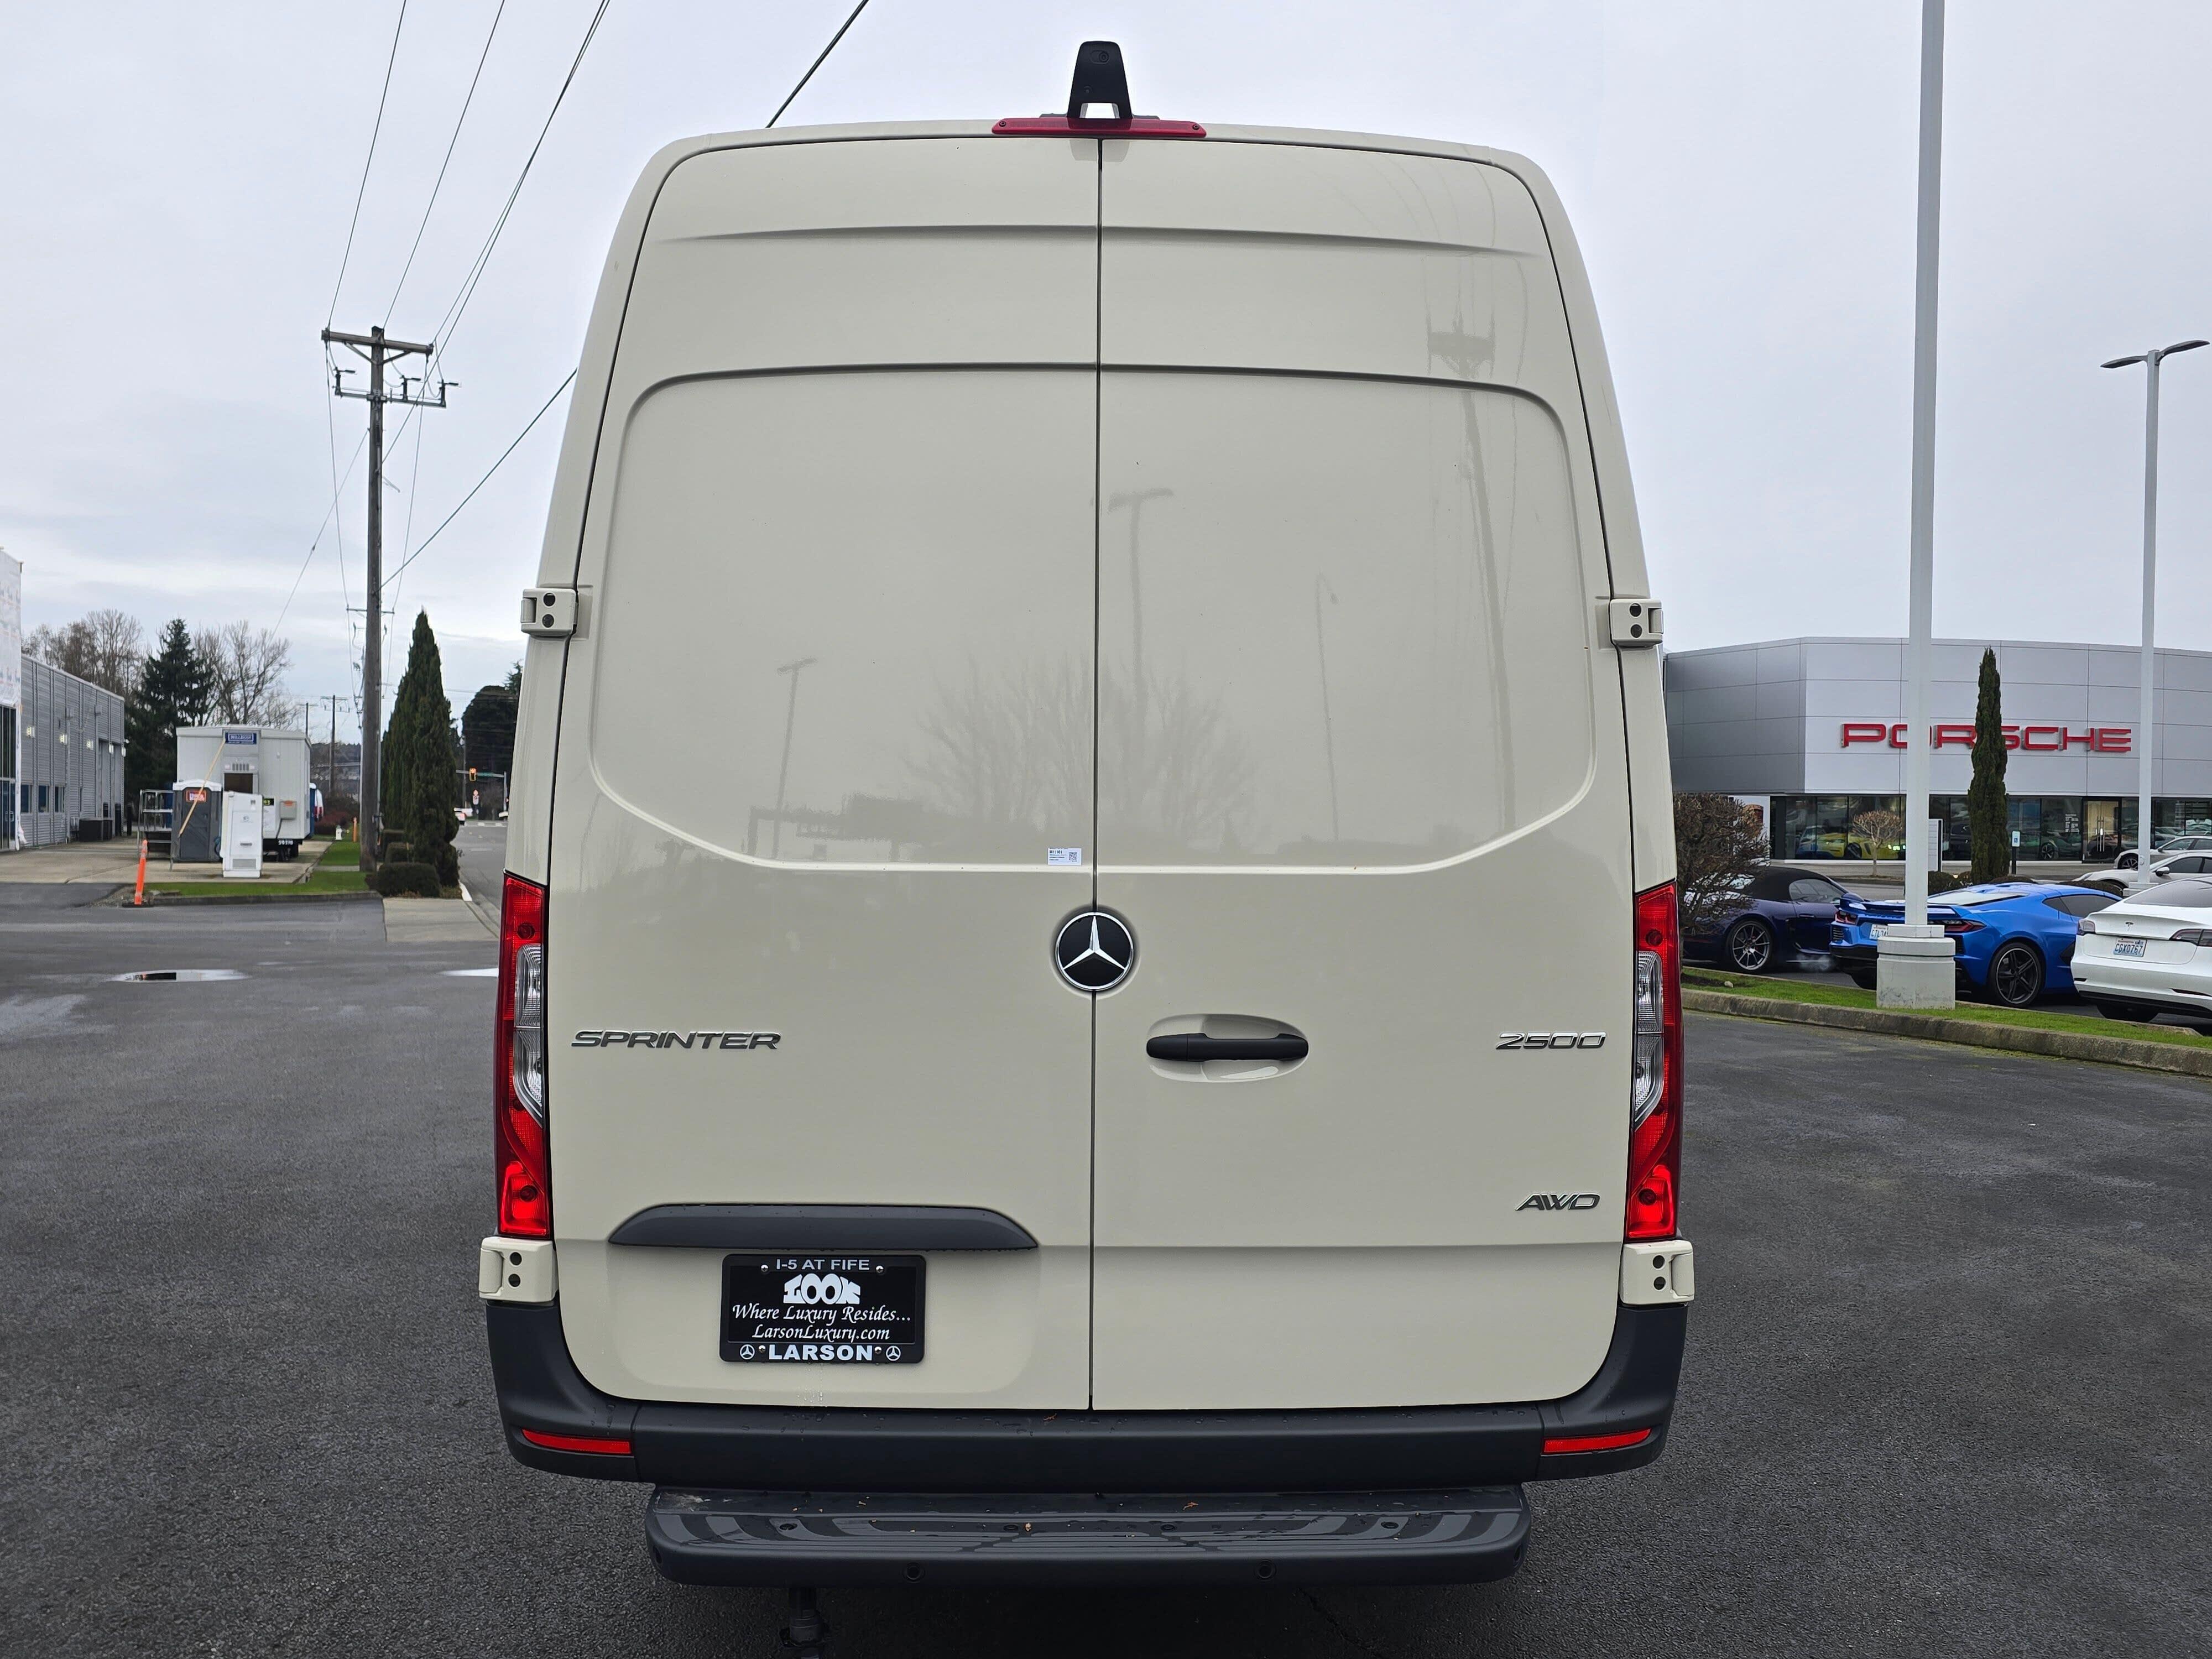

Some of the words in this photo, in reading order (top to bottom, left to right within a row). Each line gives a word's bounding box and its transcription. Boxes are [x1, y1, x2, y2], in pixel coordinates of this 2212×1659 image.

[571, 1030, 781, 1050] SPRINTER
[1496, 1032, 1606, 1049] 2500
[1515, 1193, 1600, 1211] AWD
[776, 1259, 797, 1270] I-5
[801, 1259, 825, 1270] AT
[831, 1259, 870, 1270] FIFE
[783, 1273, 861, 1305] LOOK
[732, 1303, 779, 1319] Where
[783, 1305, 837, 1326] Luxury
[841, 1305, 911, 1323] Resides...
[752, 1324, 890, 1343] LarsonLuxury.com
[768, 1345, 873, 1360] LARSON
